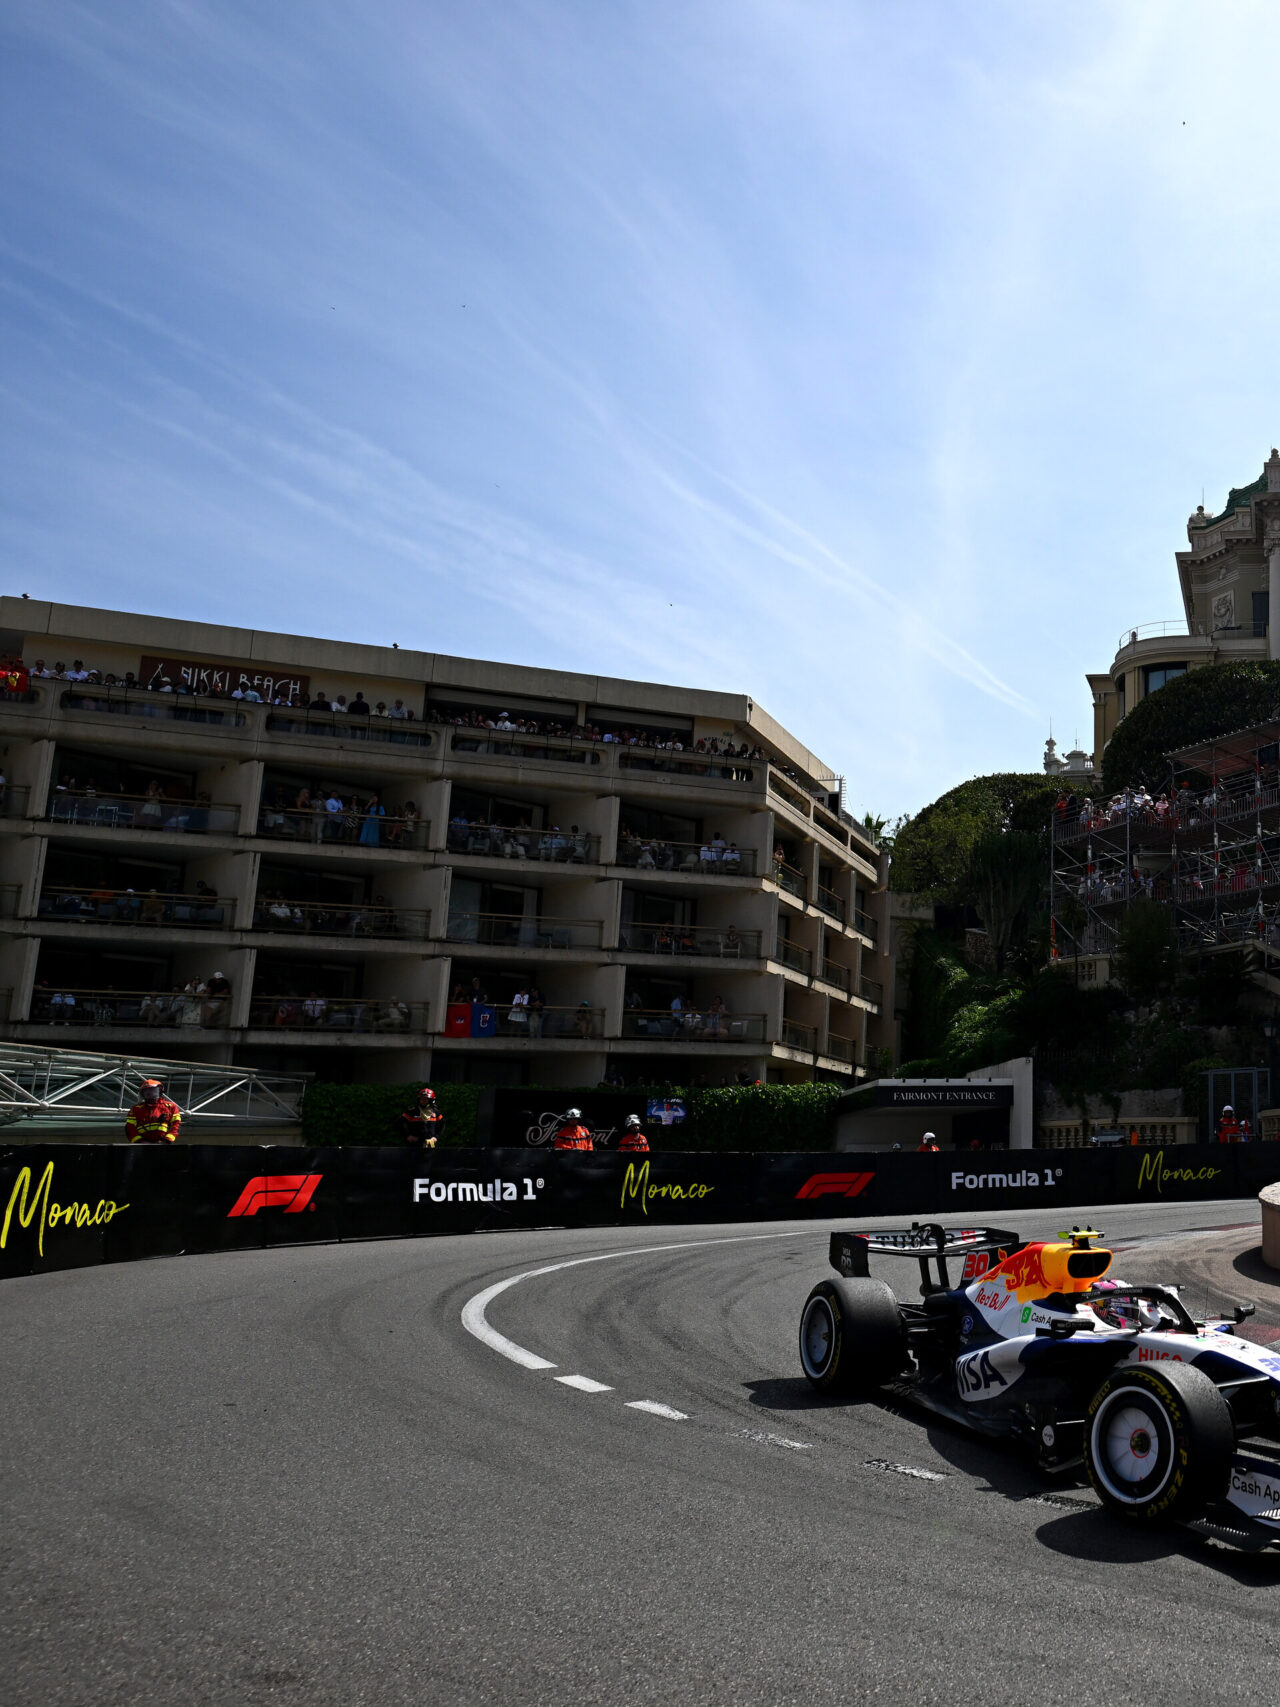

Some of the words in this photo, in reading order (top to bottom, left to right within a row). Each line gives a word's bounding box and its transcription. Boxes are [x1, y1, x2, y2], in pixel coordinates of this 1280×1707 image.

[893, 1091, 944, 1101] FAIRMONT
[946, 1091, 996, 1100] ENTRANCE
[951, 1169, 1040, 1190] Formula
[1137, 1150, 1222, 1194] Monaco
[413, 1178, 518, 1203] Formula
[620, 1160, 716, 1214] Monaco
[0, 1161, 130, 1257] Monaco
[963, 1252, 988, 1278] 30
[975, 1287, 990, 1306] Red
[988, 1292, 1012, 1312] Bull
[1031, 1312, 1047, 1324] Cash
[1231, 1475, 1262, 1497] Cash
